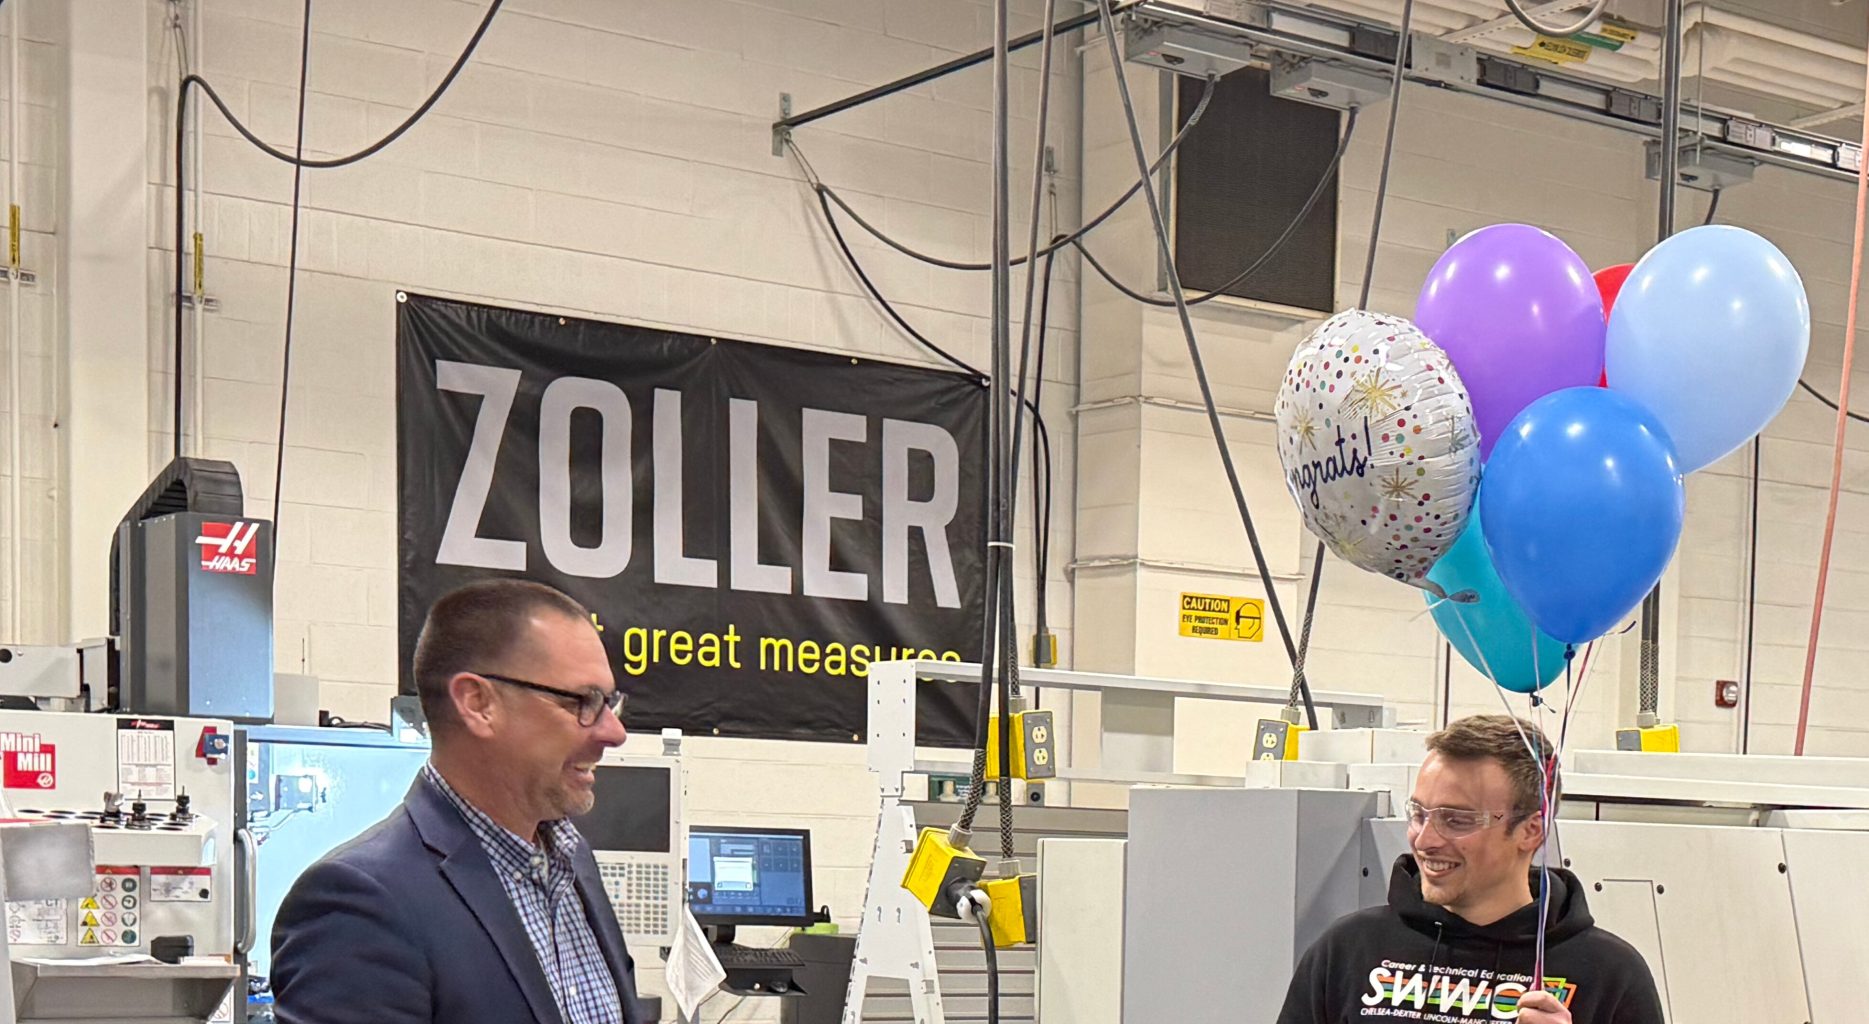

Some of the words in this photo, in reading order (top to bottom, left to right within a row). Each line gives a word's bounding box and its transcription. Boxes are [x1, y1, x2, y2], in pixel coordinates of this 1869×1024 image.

[1291, 415, 1374, 510] ngrats!
[435, 358, 962, 609] ZOLLER
[201, 555, 257, 572] HAAS
[1183, 596, 1229, 613] CAUTION
[623, 623, 742, 676] great
[0, 732, 41, 753] Mini
[17, 752, 52, 772] Mill
[1381, 959, 1417, 971] Career
[1418, 964, 1426, 972] &
